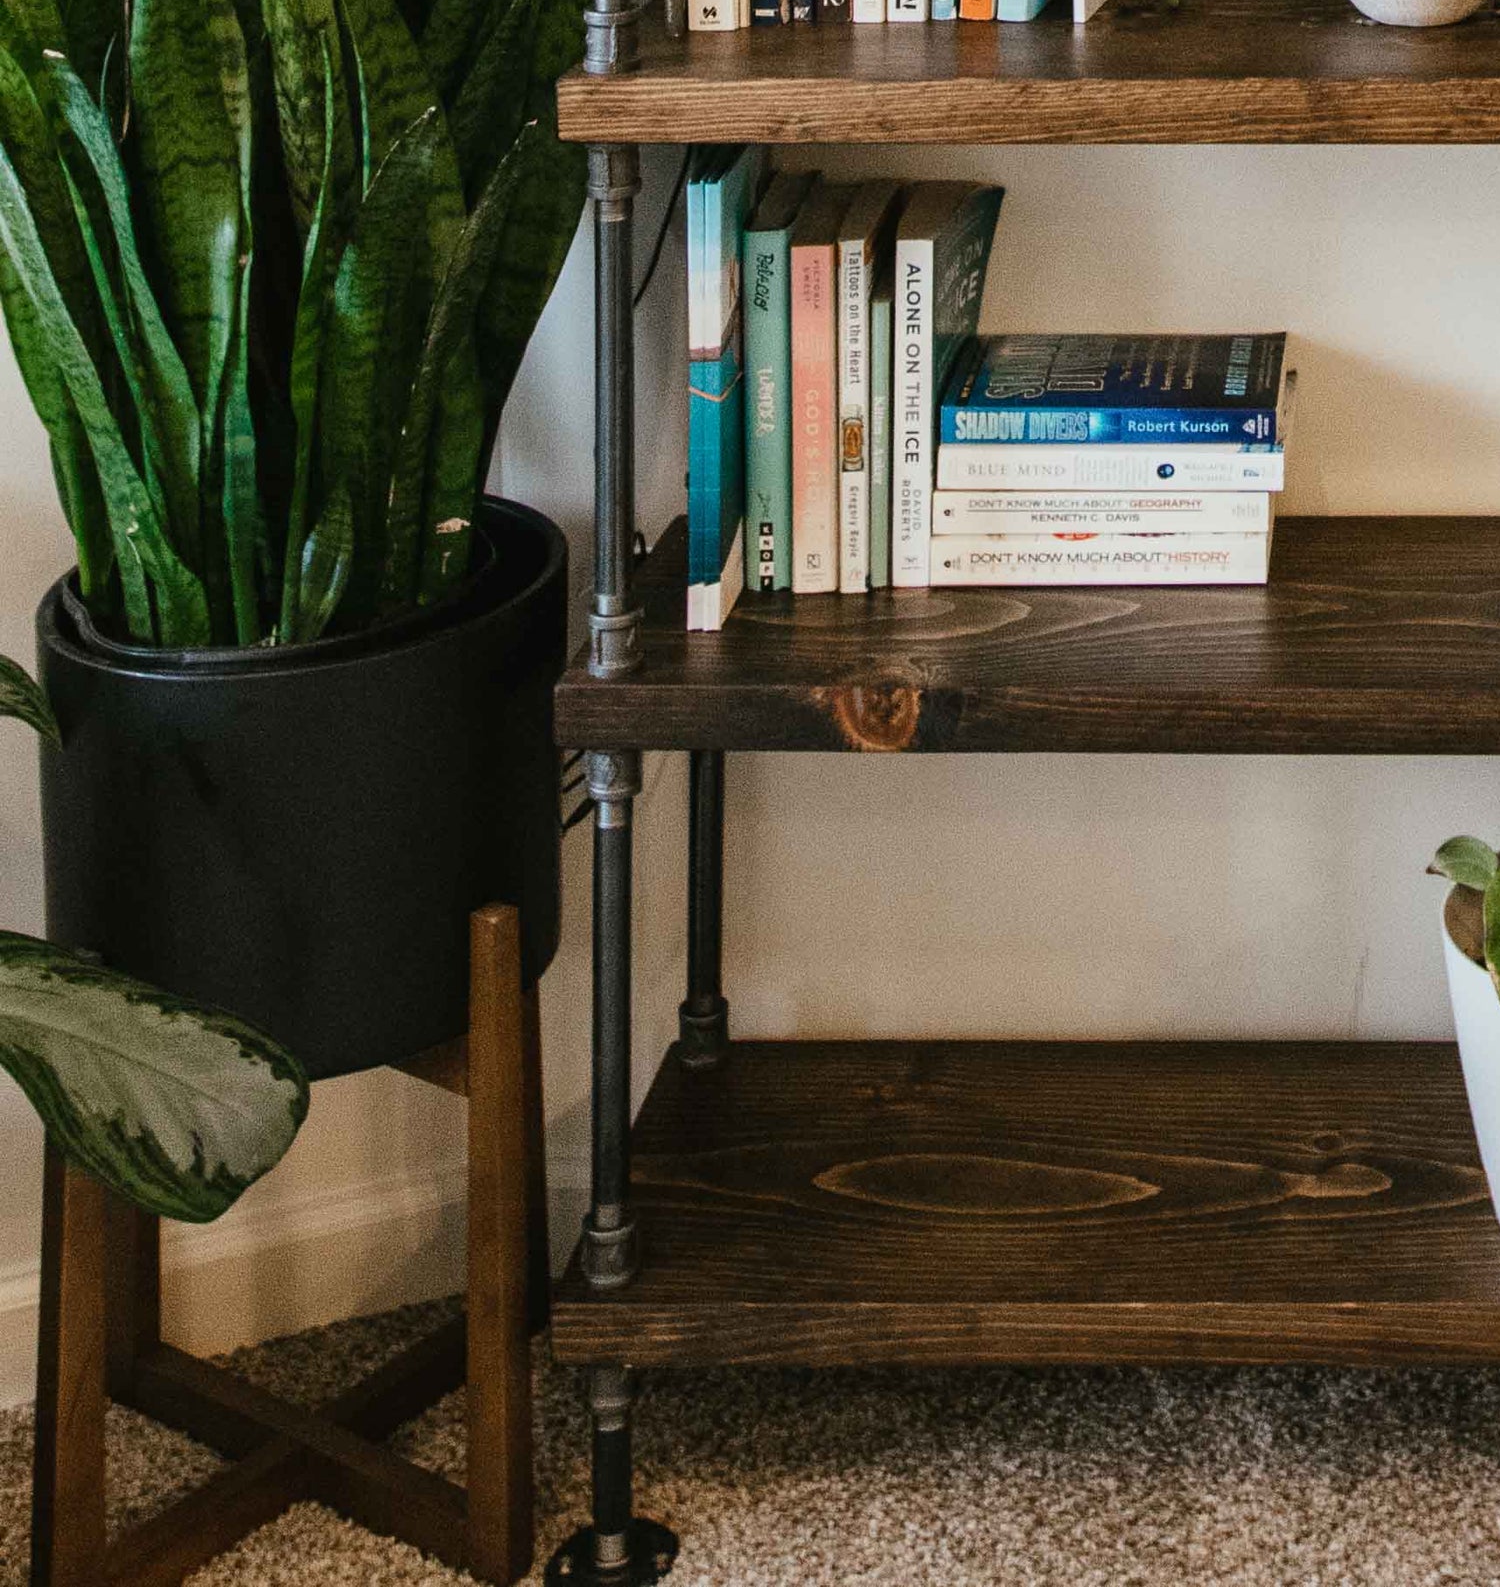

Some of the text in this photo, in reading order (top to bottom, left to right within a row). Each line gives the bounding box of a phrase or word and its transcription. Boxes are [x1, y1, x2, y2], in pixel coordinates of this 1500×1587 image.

[848, 251, 863, 385] Tattoos on the Heart
[905, 263, 921, 464] ALONE ON THE ICE
[955, 411, 1088, 440] SHADOW DIVERS
[1128, 419, 1229, 433] Robert Kurson
[967, 464, 1066, 475] BLUE MIND
[901, 478, 911, 542] ROBERTS
[969, 499, 1003, 509] DON'T
[1007, 499, 1041, 509] KNOW
[1045, 499, 1079, 509] MUCH
[1129, 499, 1203, 509] GEOGRAPHY
[1031, 513, 1140, 522] KENNETH DAVIS
[970, 552, 1013, 564] DON'T
[1017, 552, 1063, 564] KNOW
[1067, 552, 1109, 564] MUCH
[1168, 551, 1230, 563] HISTORY
